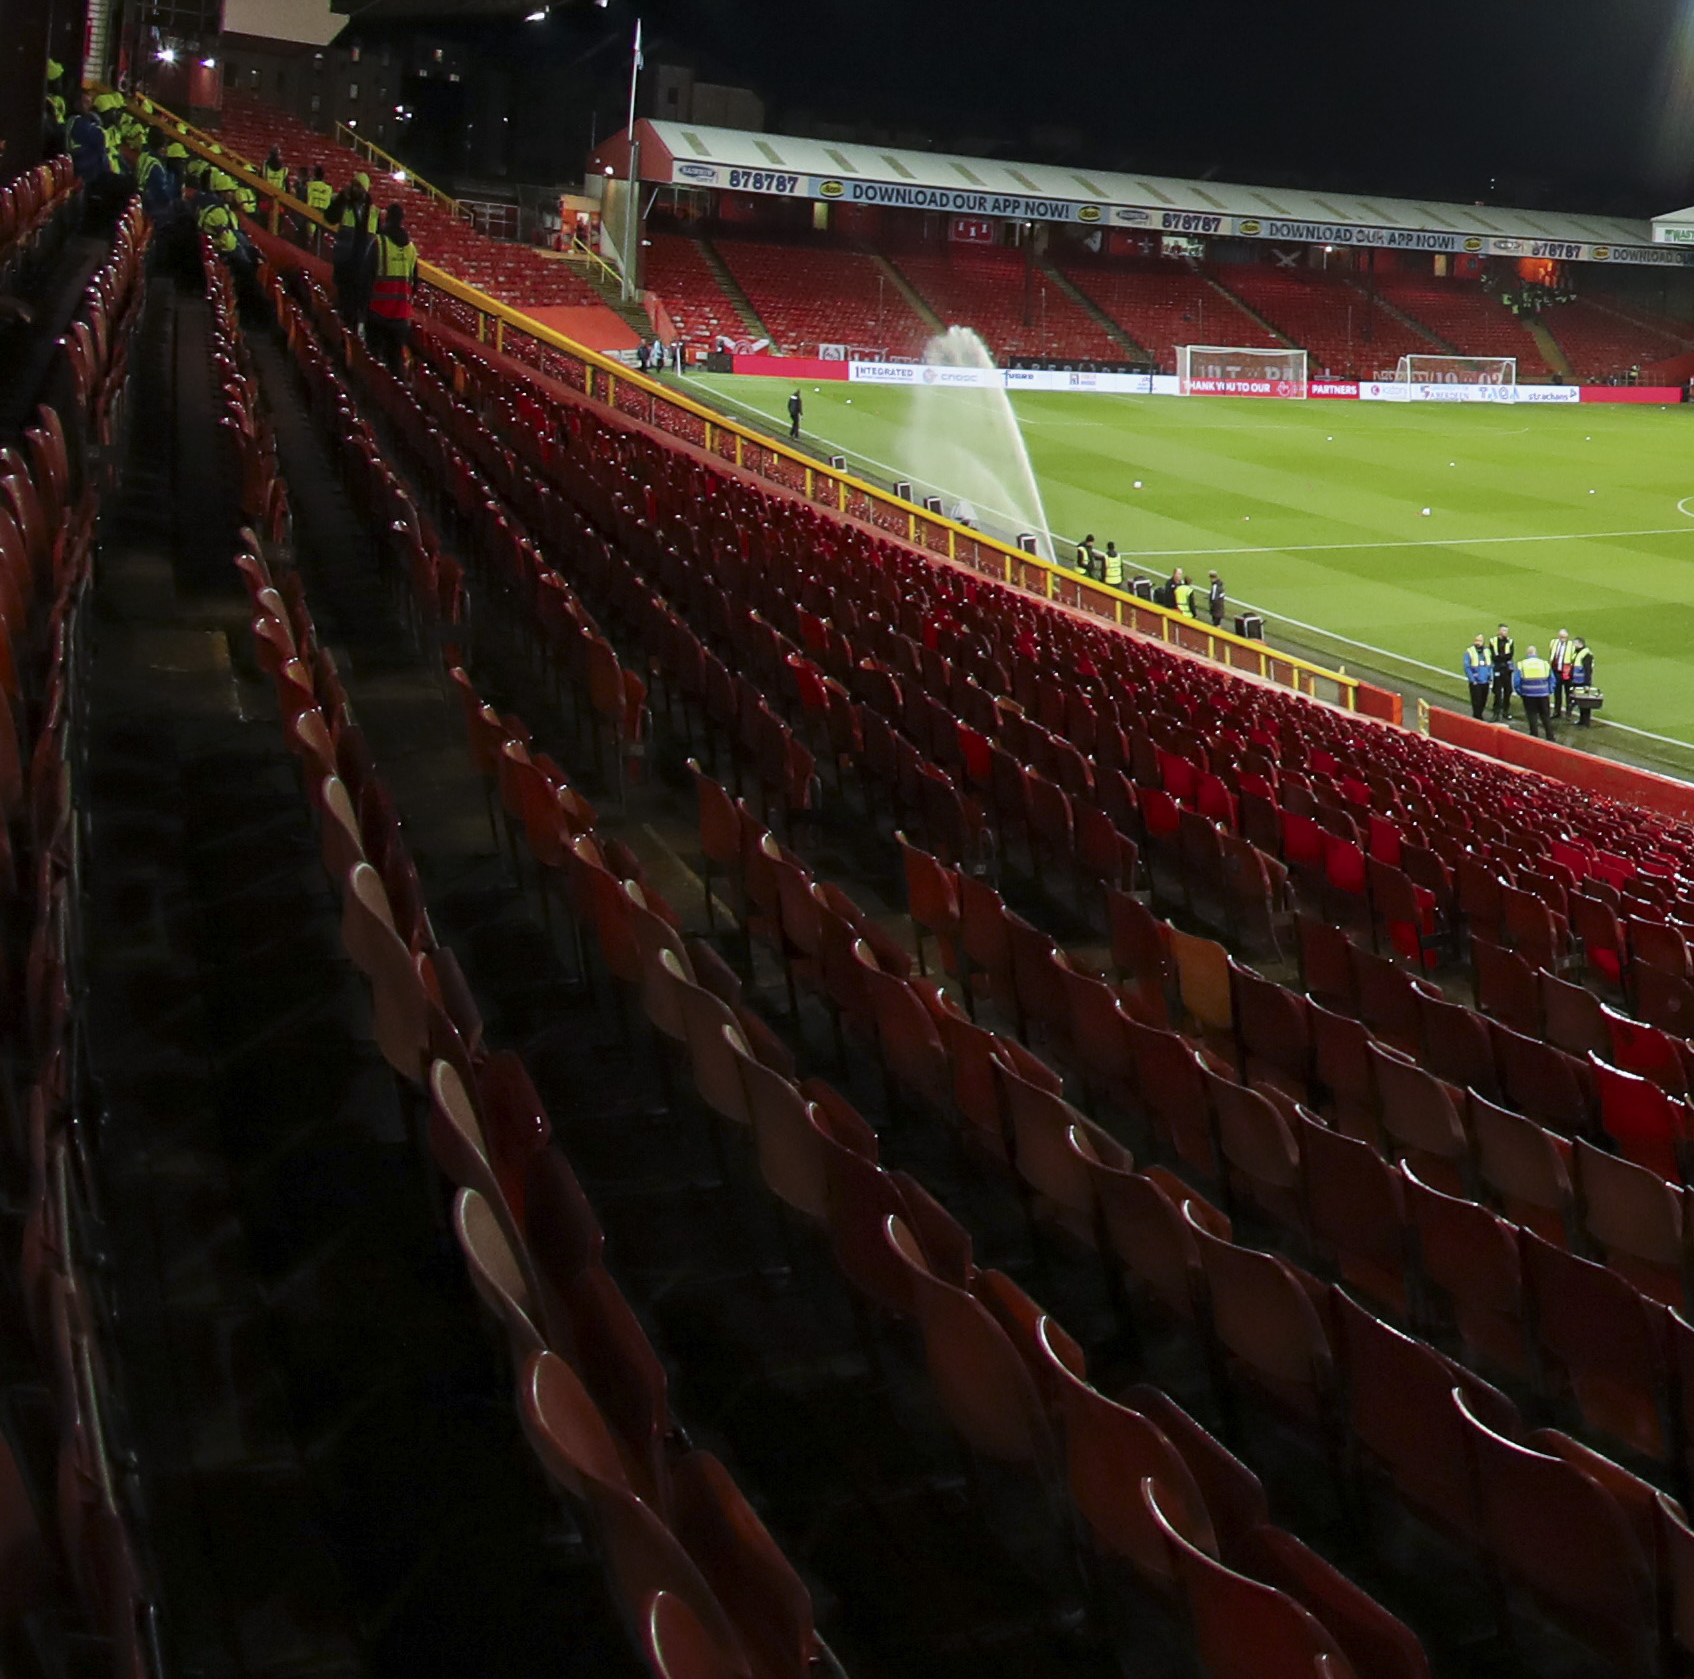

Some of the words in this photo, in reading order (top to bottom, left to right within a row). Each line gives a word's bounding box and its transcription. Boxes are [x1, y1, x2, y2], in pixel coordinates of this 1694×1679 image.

[729, 170, 799, 193] 878787
[853, 184, 949, 207] DOWNLOAD
[953, 194, 987, 212] OUR
[991, 197, 1020, 214] APP
[1025, 202, 1070, 219] NOW!
[1162, 212, 1223, 233] 878787
[1269, 223, 1352, 242] DOWNLOAD
[1354, 229, 1385, 244] OUR
[1388, 232, 1413, 246] APP
[1416, 235, 1455, 249] NOW!
[1531, 242, 1581, 259] 878787
[1613, 248, 1673, 264] DOWNLOAD
[855, 366, 914, 378] INTEGRATED
[1216, 381, 1236, 391] YOU
[1238, 382, 1250, 392] TO
[1251, 383, 1271, 393] OUR
[1312, 384, 1357, 395] PARTNERS
